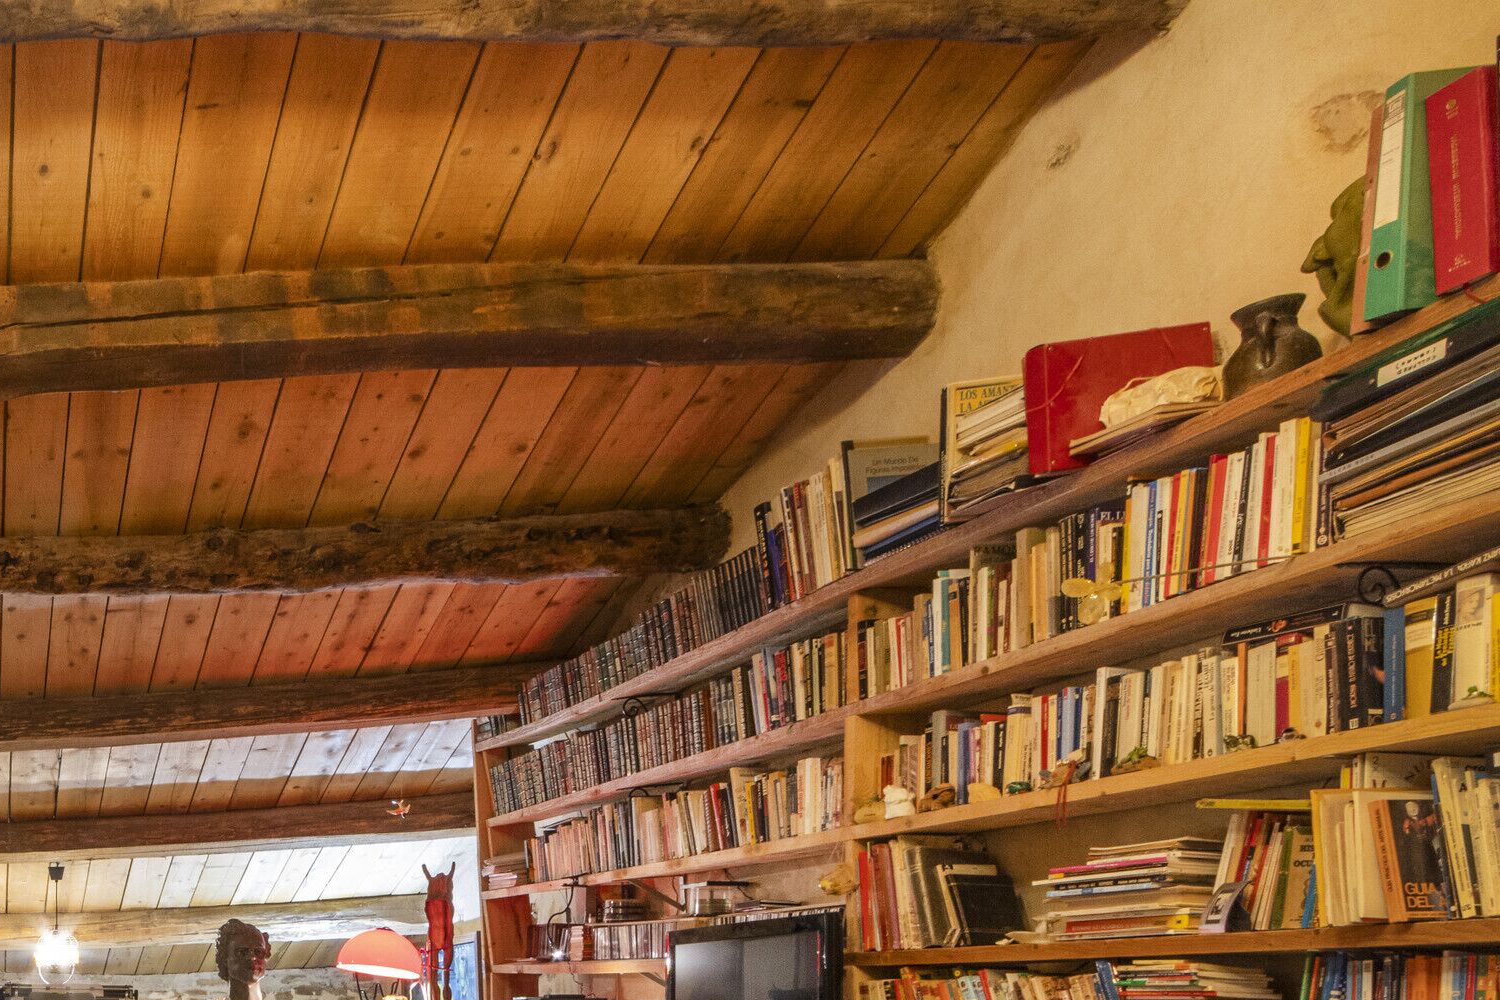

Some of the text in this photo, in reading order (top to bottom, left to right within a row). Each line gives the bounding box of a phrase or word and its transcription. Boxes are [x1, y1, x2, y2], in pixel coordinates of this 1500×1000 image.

[960, 388, 976, 400] LOS
[1404, 881, 1436, 894] GUIA
[1406, 895, 1434, 908] DEL
